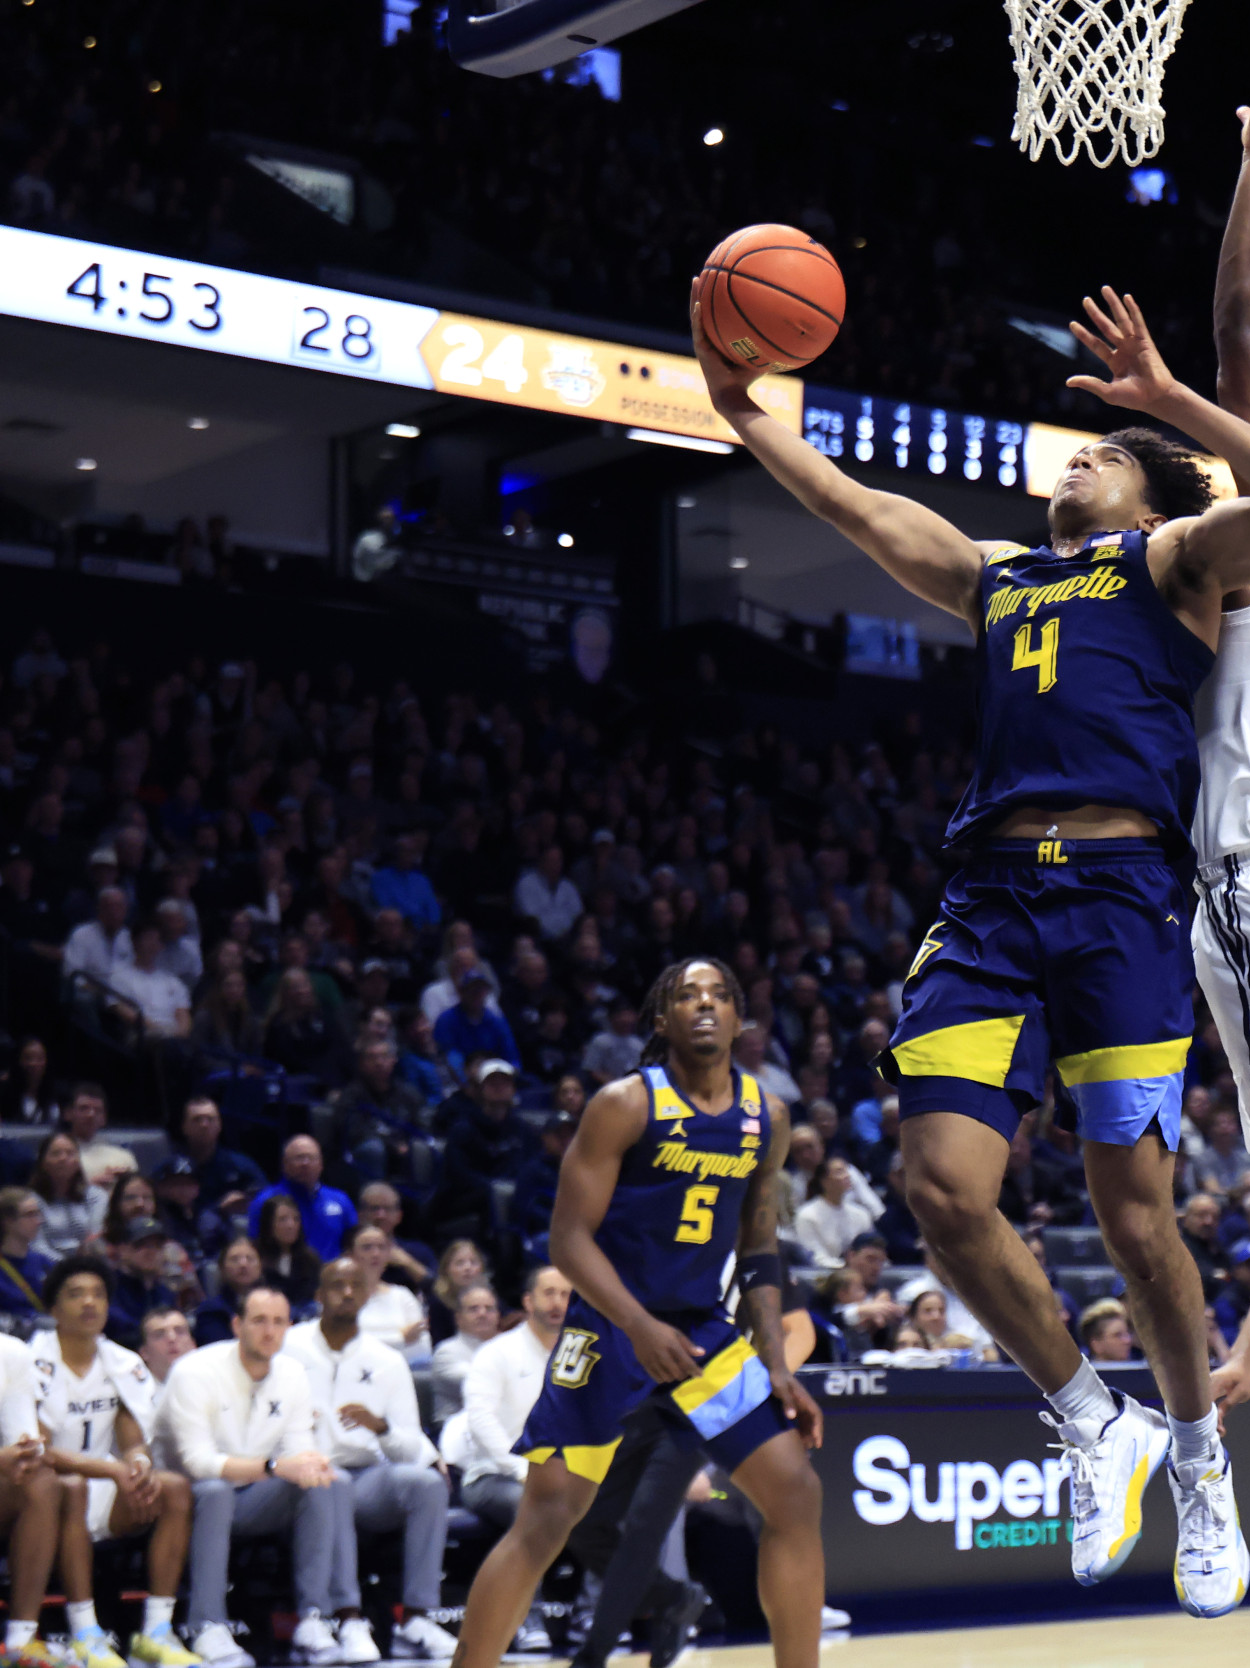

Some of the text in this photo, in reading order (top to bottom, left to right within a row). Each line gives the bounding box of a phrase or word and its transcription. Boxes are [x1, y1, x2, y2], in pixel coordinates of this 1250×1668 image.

[66, 262, 375, 359] 4:53 28
[439, 323, 528, 393] 24
[621, 396, 716, 428] POSSESSION
[805, 408, 844, 434] PTS
[985, 566, 1128, 633] Marquette
[1011, 617, 1060, 694] 4
[1038, 841, 1068, 863] AL
[674, 1184, 720, 1245] 5
[824, 1370, 888, 1396] anc
[82, 1420, 92, 1451] 1
[853, 1434, 1074, 1551] Super
[974, 1519, 1061, 1550] CREDIT
